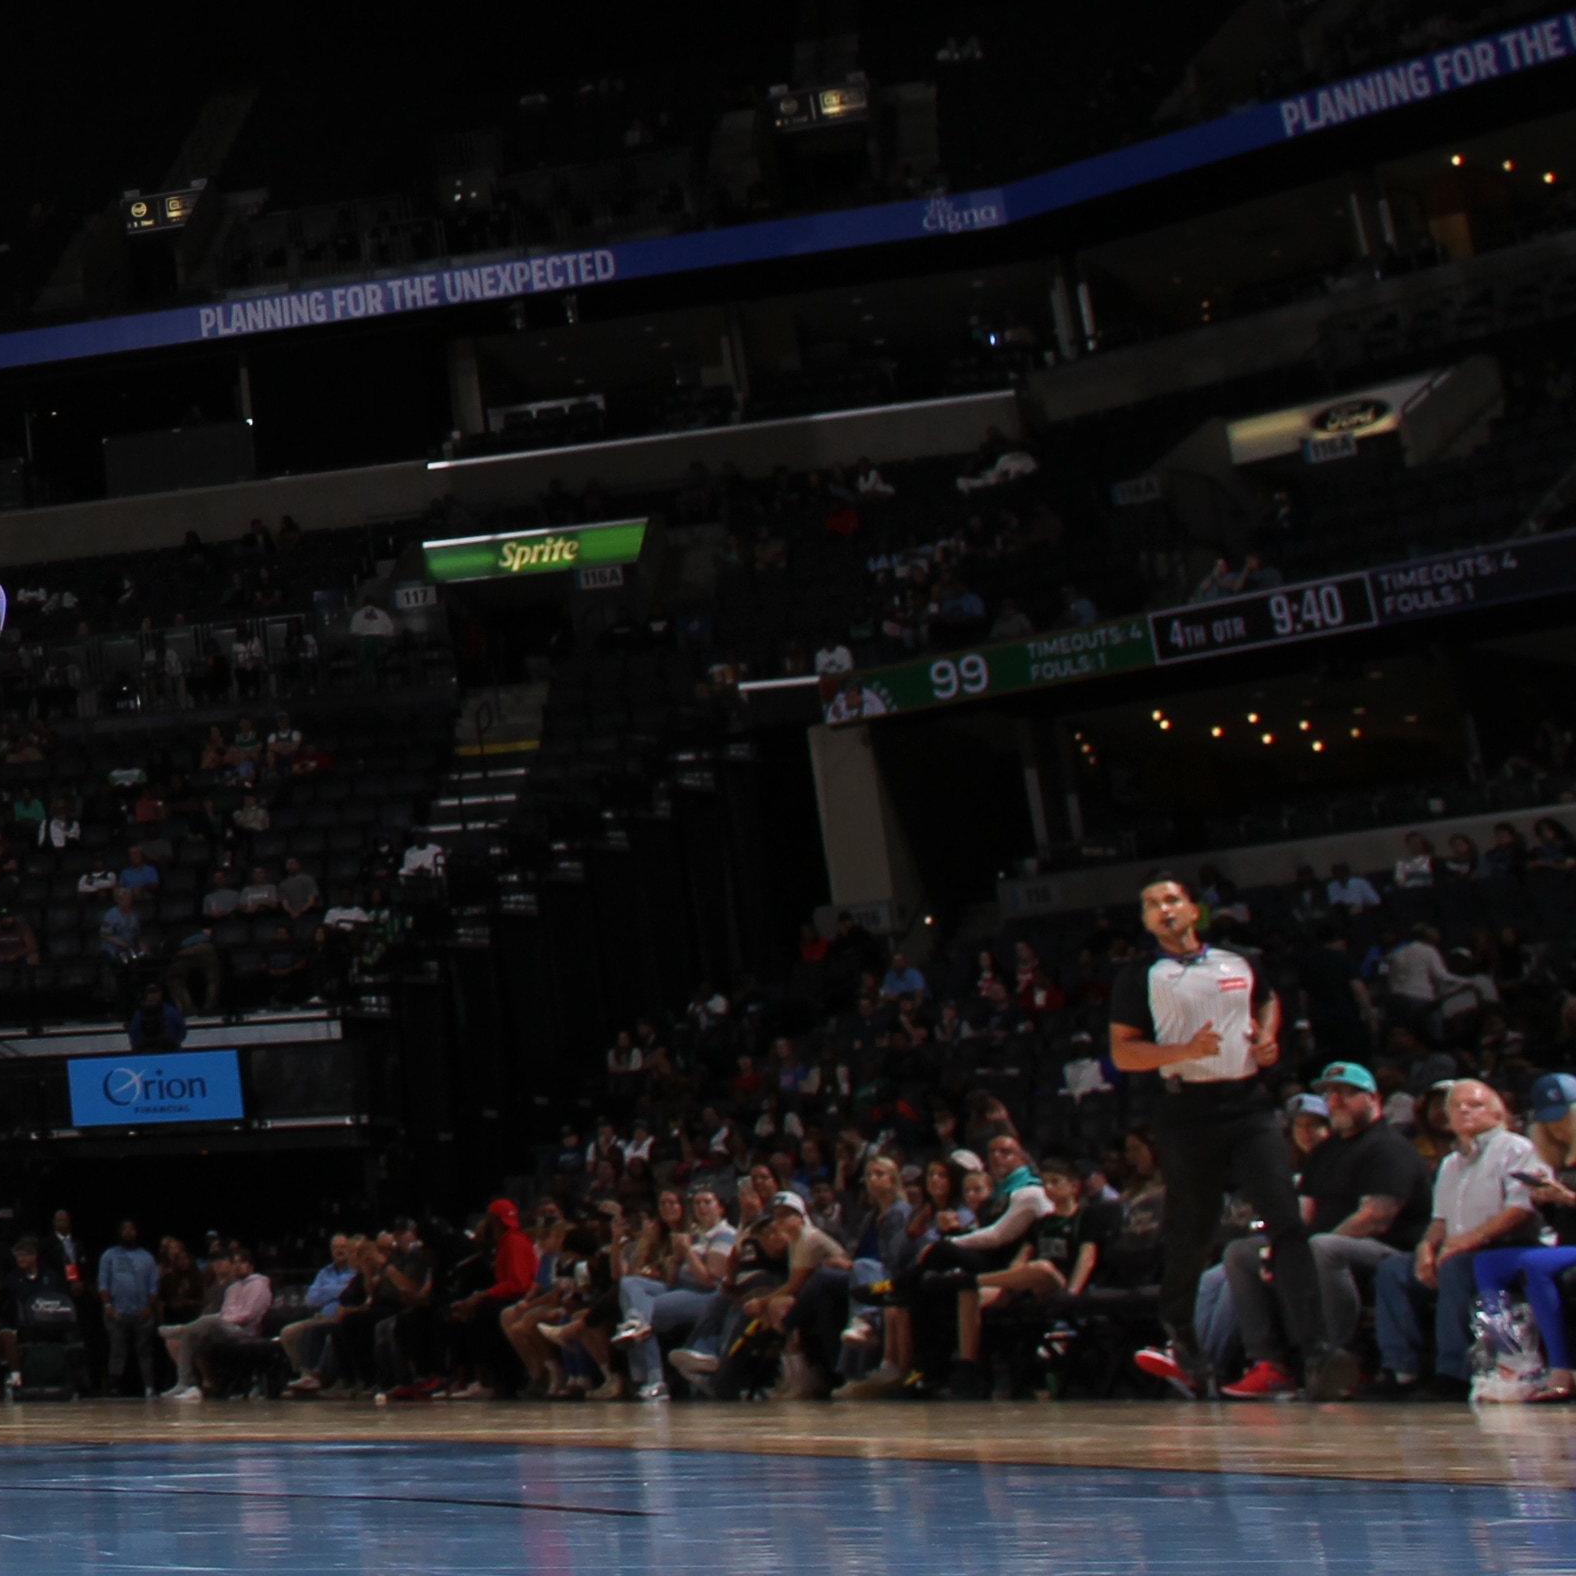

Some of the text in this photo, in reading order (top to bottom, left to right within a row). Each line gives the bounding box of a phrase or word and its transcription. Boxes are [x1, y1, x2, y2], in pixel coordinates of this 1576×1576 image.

[1280, 60, 1431, 137] PLANNING
[1432, 40, 1498, 92] FOR
[1499, 18, 1567, 71] THE
[923, 200, 998, 234] cigna
[199, 249, 616, 337] PLANNING FOR THE UNEXPECTED
[498, 536, 579, 573] Sprite
[1379, 553, 1518, 594] TIMEOUTS: 4
[404, 589, 428, 605] 117
[1383, 584, 1459, 616] FOULS:
[1169, 619, 1207, 651] 4TH
[1269, 584, 1344, 636] 9:40
[1027, 624, 1144, 660] TIMEOUTS: 4
[929, 653, 988, 700] 99
[1029, 656, 1095, 682] FOULS:
[103, 1067, 207, 1107] Orion
